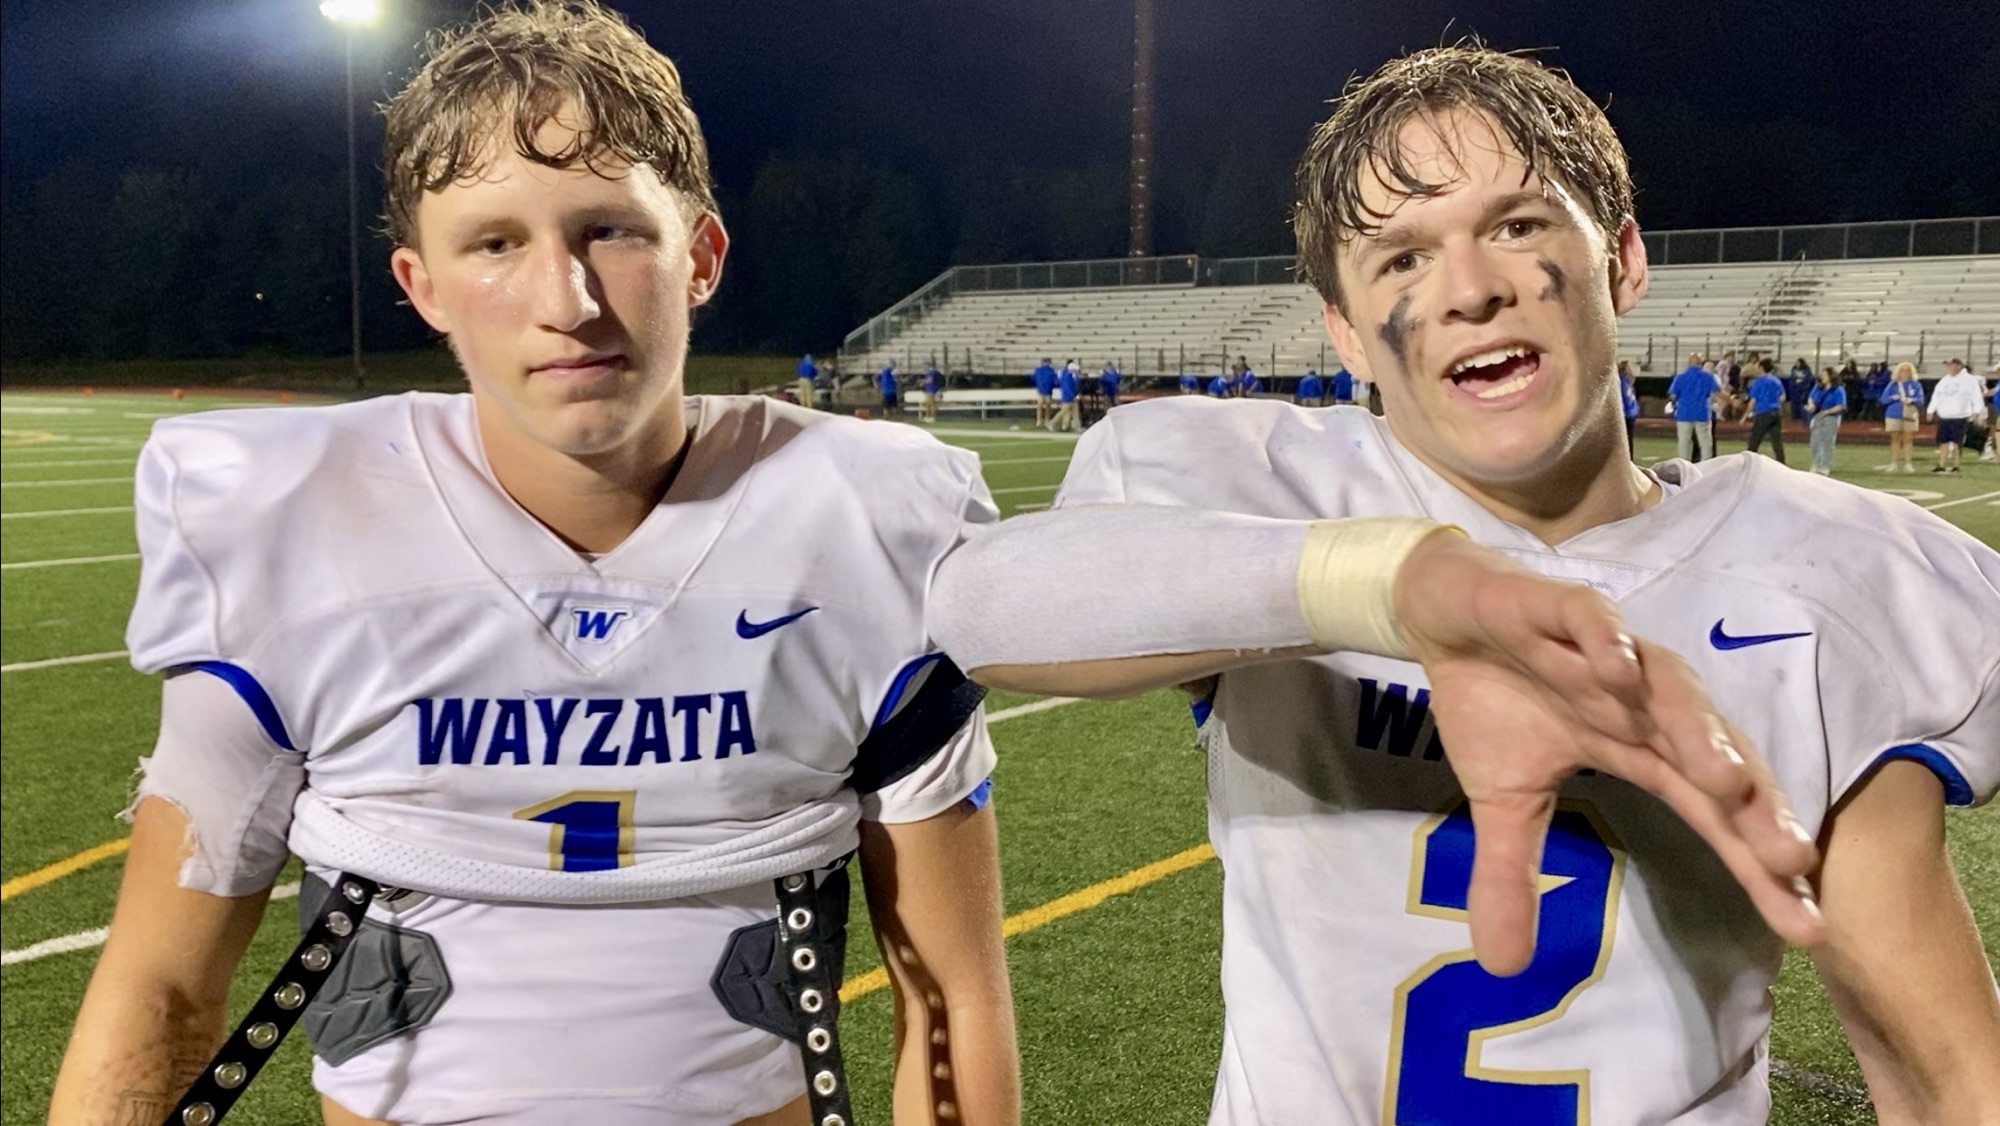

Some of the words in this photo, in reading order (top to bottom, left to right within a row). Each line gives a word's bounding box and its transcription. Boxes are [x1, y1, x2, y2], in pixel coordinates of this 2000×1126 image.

[573, 610, 627, 639] W
[412, 690, 757, 767] WAYZATA
[512, 788, 638, 873] 1
[1382, 796, 1629, 1126] 2
